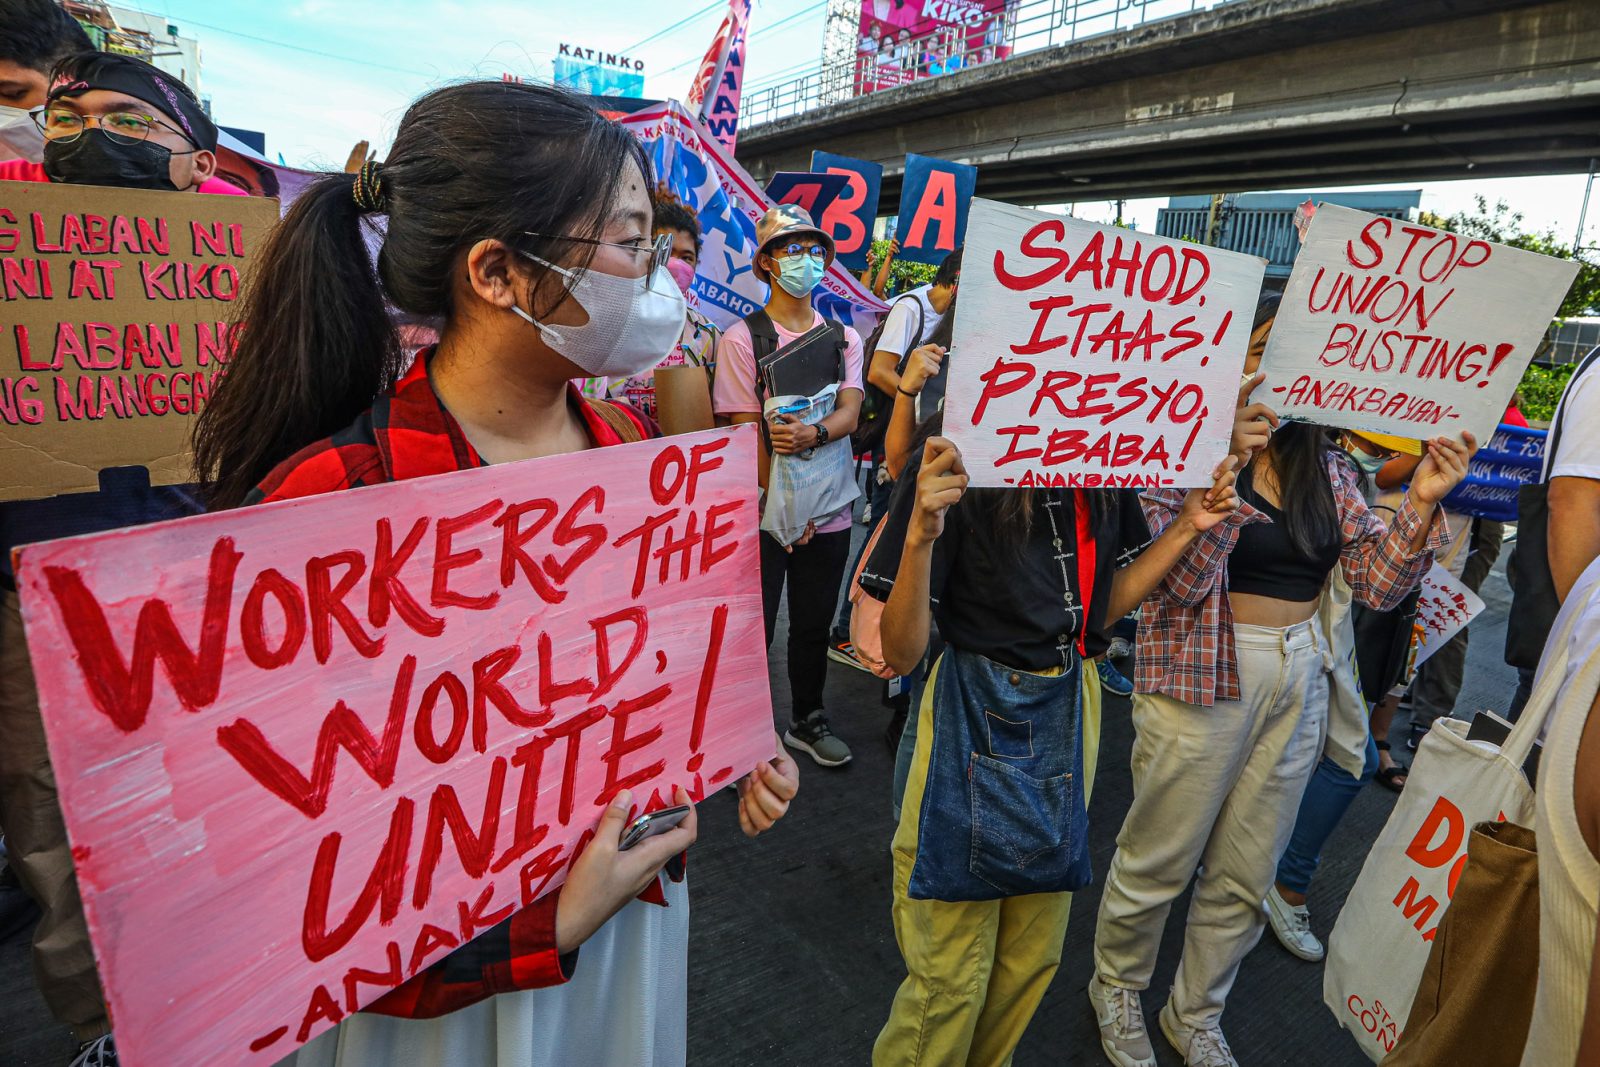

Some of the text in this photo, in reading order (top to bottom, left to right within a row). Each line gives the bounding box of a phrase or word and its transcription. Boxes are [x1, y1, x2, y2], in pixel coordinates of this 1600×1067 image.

[921, 0, 984, 28] KIKO
[559, 43, 645, 71] KATINKO
[30, 211, 170, 255] LABAN
[191, 220, 245, 257] NI
[821, 167, 868, 254] B
[903, 169, 957, 251] A
[0, 257, 240, 301] NI AT KIKO
[993, 219, 1211, 306] SAHOD,
[1346, 217, 1492, 284] STOP
[1009, 295, 1233, 367] ITAAS!
[1308, 266, 1455, 331] UNION
[14, 321, 183, 371] LABAN
[1317, 322, 1514, 388] BUSTING!
[54, 371, 228, 421] MANGGA
[971, 356, 1208, 426] PRESYO,
[1272, 375, 1461, 424] -ANAKBAYAN-
[993, 419, 1203, 472] IBABA!
[612, 499, 746, 600] THE
[44, 437, 730, 732] WORKERS OF
[216, 605, 668, 819] WORLD,
[302, 603, 729, 962] UNITE!
